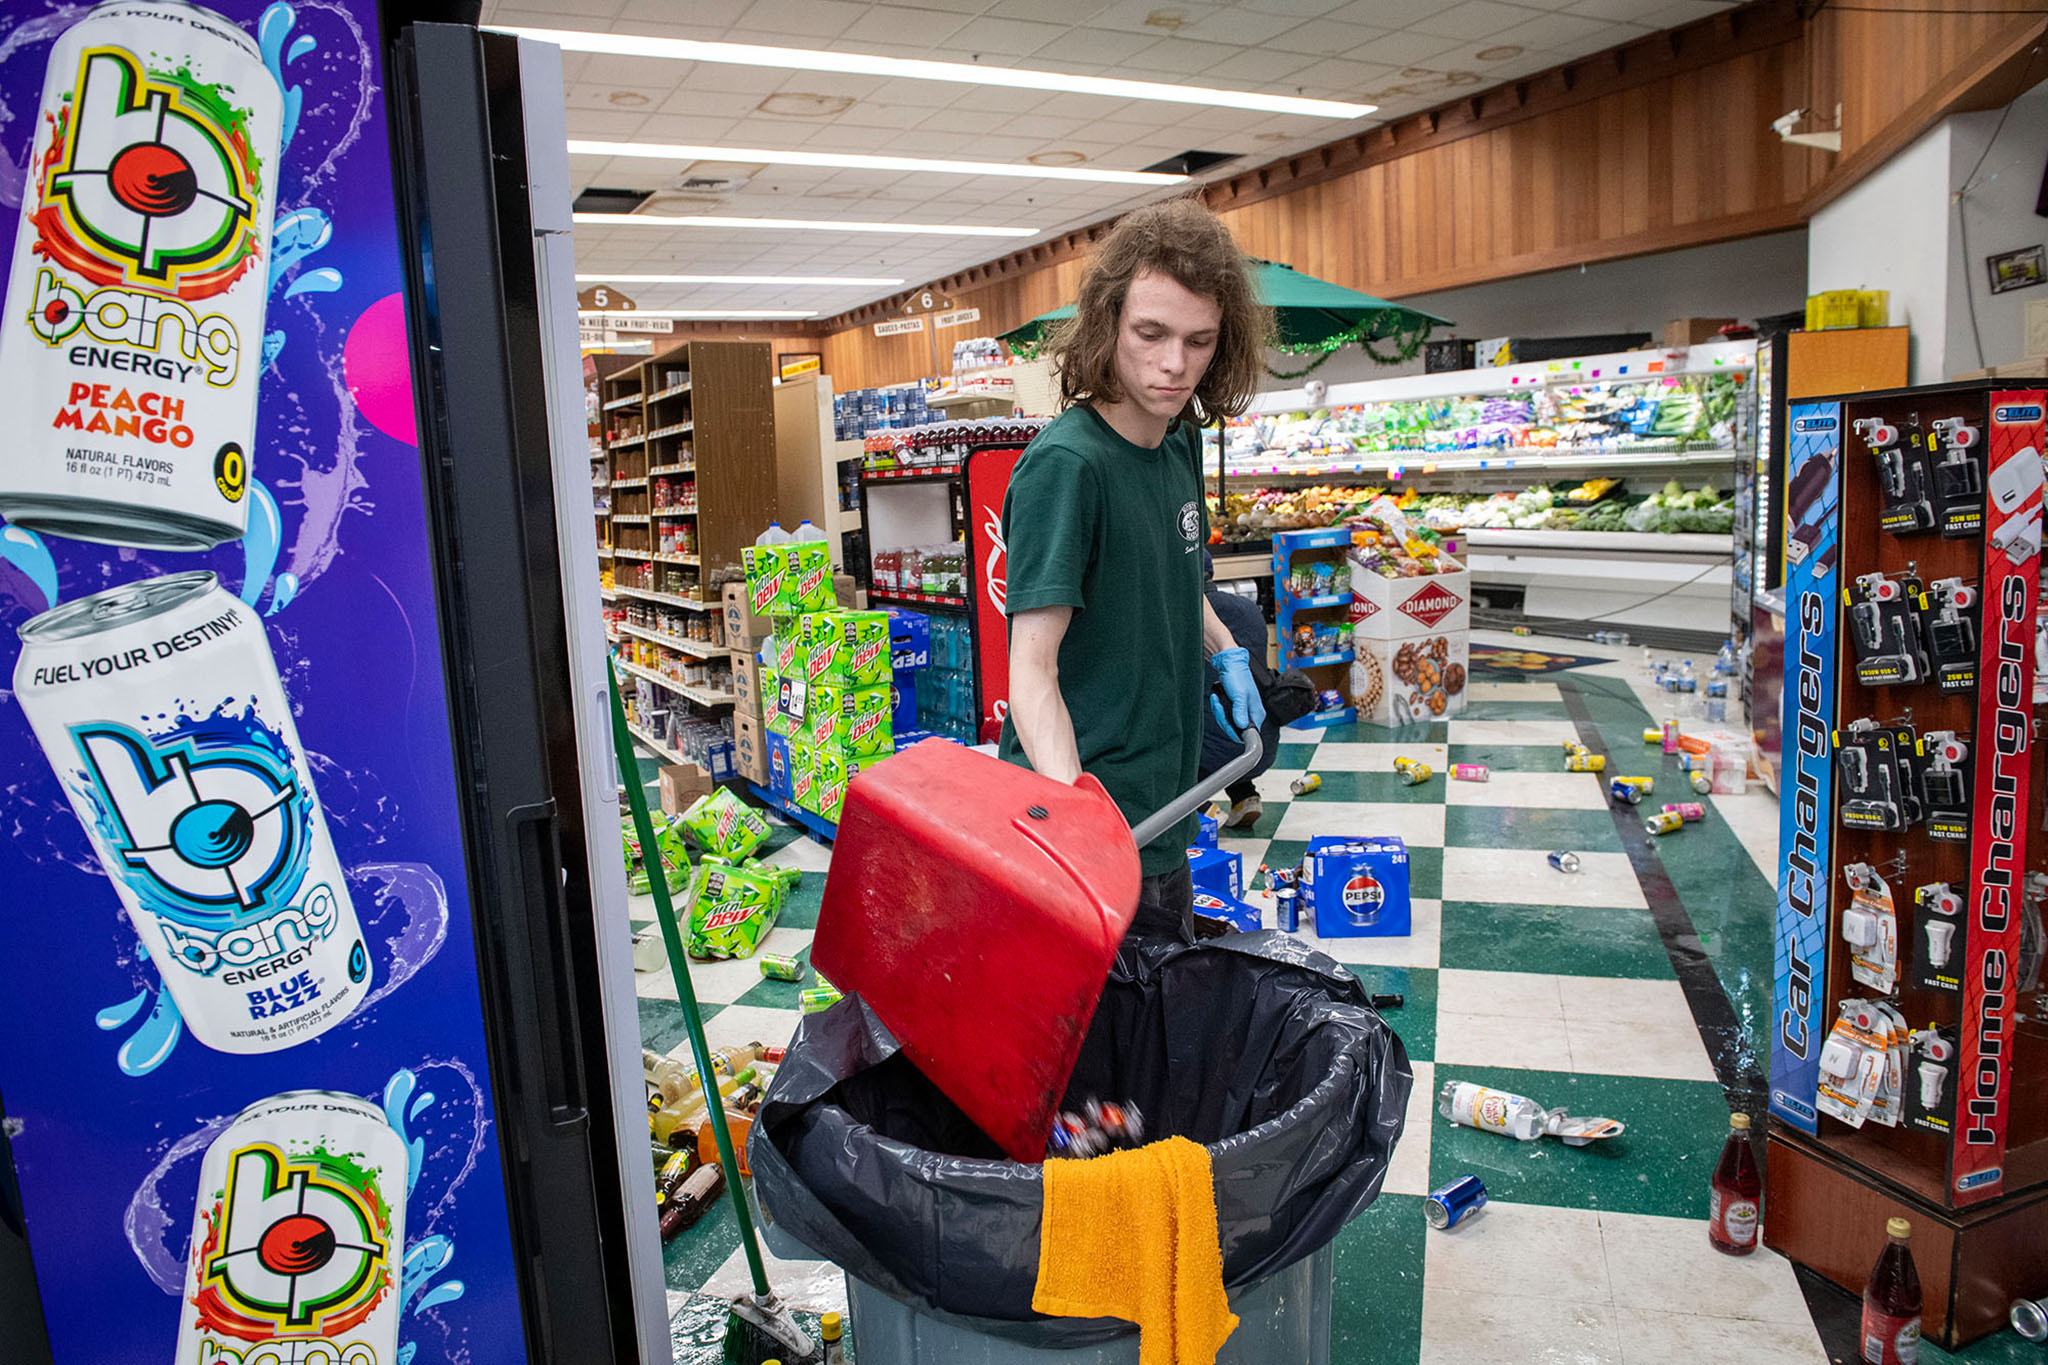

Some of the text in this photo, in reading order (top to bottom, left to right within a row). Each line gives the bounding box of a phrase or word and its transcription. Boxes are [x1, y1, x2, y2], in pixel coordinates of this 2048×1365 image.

[595, 289, 608, 307] 5
[921, 292, 933, 308] 6
[25, 268, 240, 388] bang
[68, 381, 184, 421] PEACH
[52, 406, 194, 448] MANGO
[66, 448, 173, 474] NATURAL FLAVORS
[66, 462, 77, 473] 16
[89, 466, 101, 475] oz
[116, 468, 133, 481] PT)
[135, 472, 155, 484] 473
[157, 475, 172, 487] mL
[223, 451, 243, 487] 0
[1406, 596, 1457, 613] DIAMOND
[34, 610, 243, 686] FUEL YOUR DESTINY!
[892, 650, 927, 669] PEP
[1788, 591, 1828, 919] Chargers
[1981, 575, 2027, 933] Chargers
[1228, 860, 1238, 900] PEP
[1346, 891, 1381, 900] PEPSI
[159, 881, 339, 978] bang
[246, 969, 313, 1006] BLUE
[1782, 934, 1811, 1061] Car
[1925, 978, 1939, 986] FAST
[278, 1009, 321, 1032] ARTIFICIAL
[321, 986, 350, 1012] FLAVORS
[1967, 949, 2006, 1145] Home
[1915, 1118, 1930, 1127] FAST
